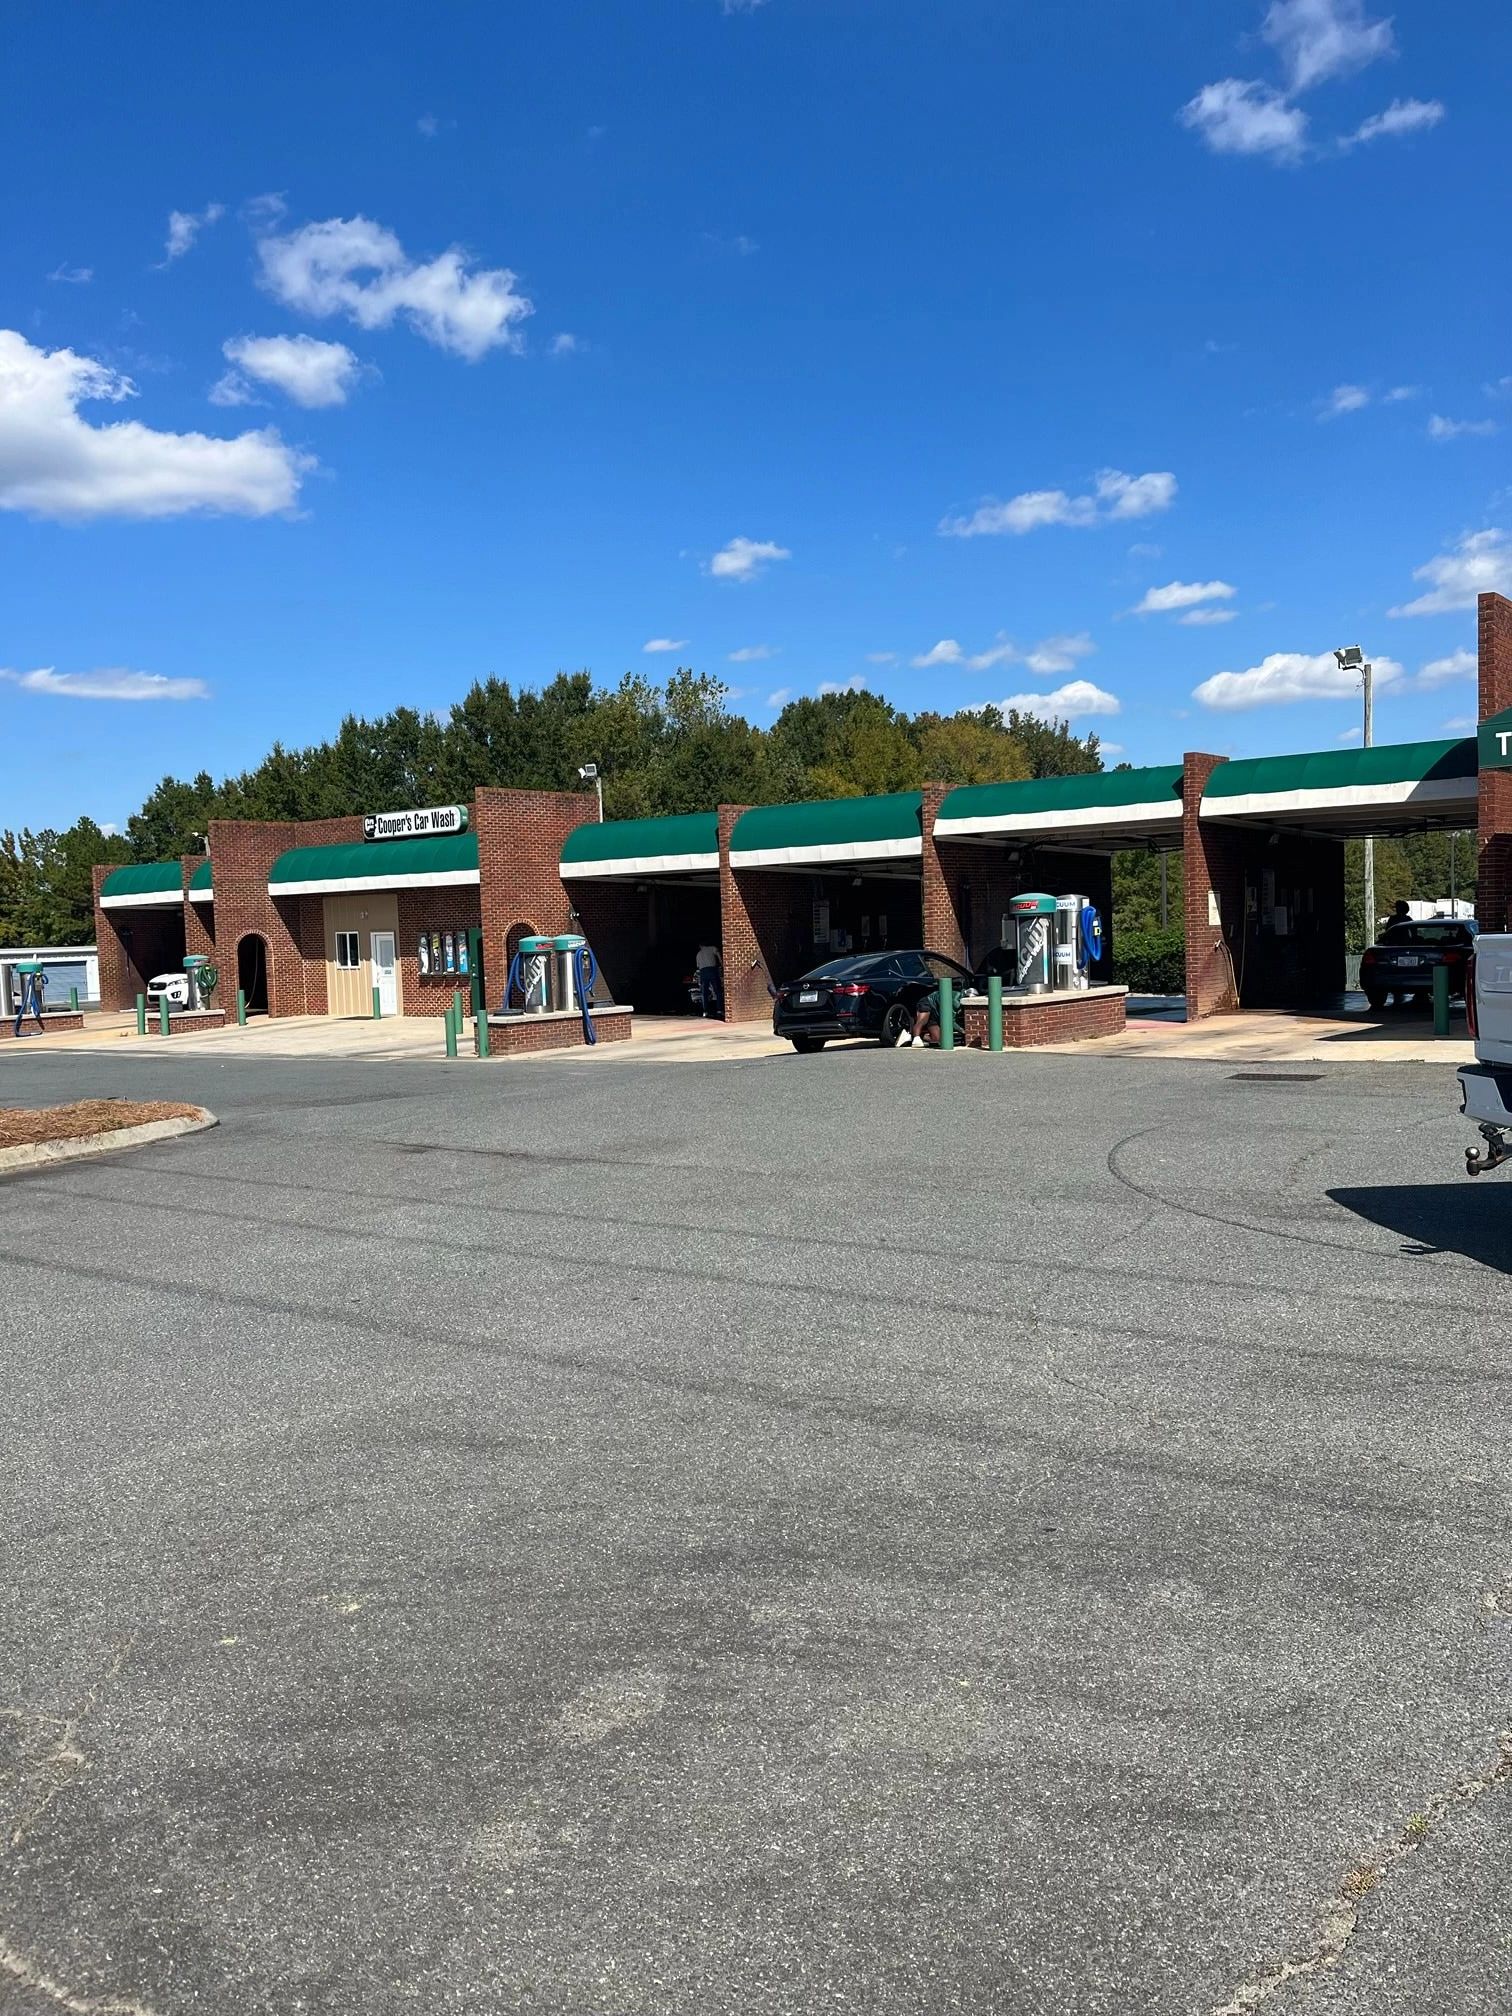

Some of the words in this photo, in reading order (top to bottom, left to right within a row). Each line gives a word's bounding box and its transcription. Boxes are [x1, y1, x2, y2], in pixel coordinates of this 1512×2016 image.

[378, 814, 412, 835] Cooper's
[414, 813, 429, 831] Car
[431, 810, 455, 828] Wash
